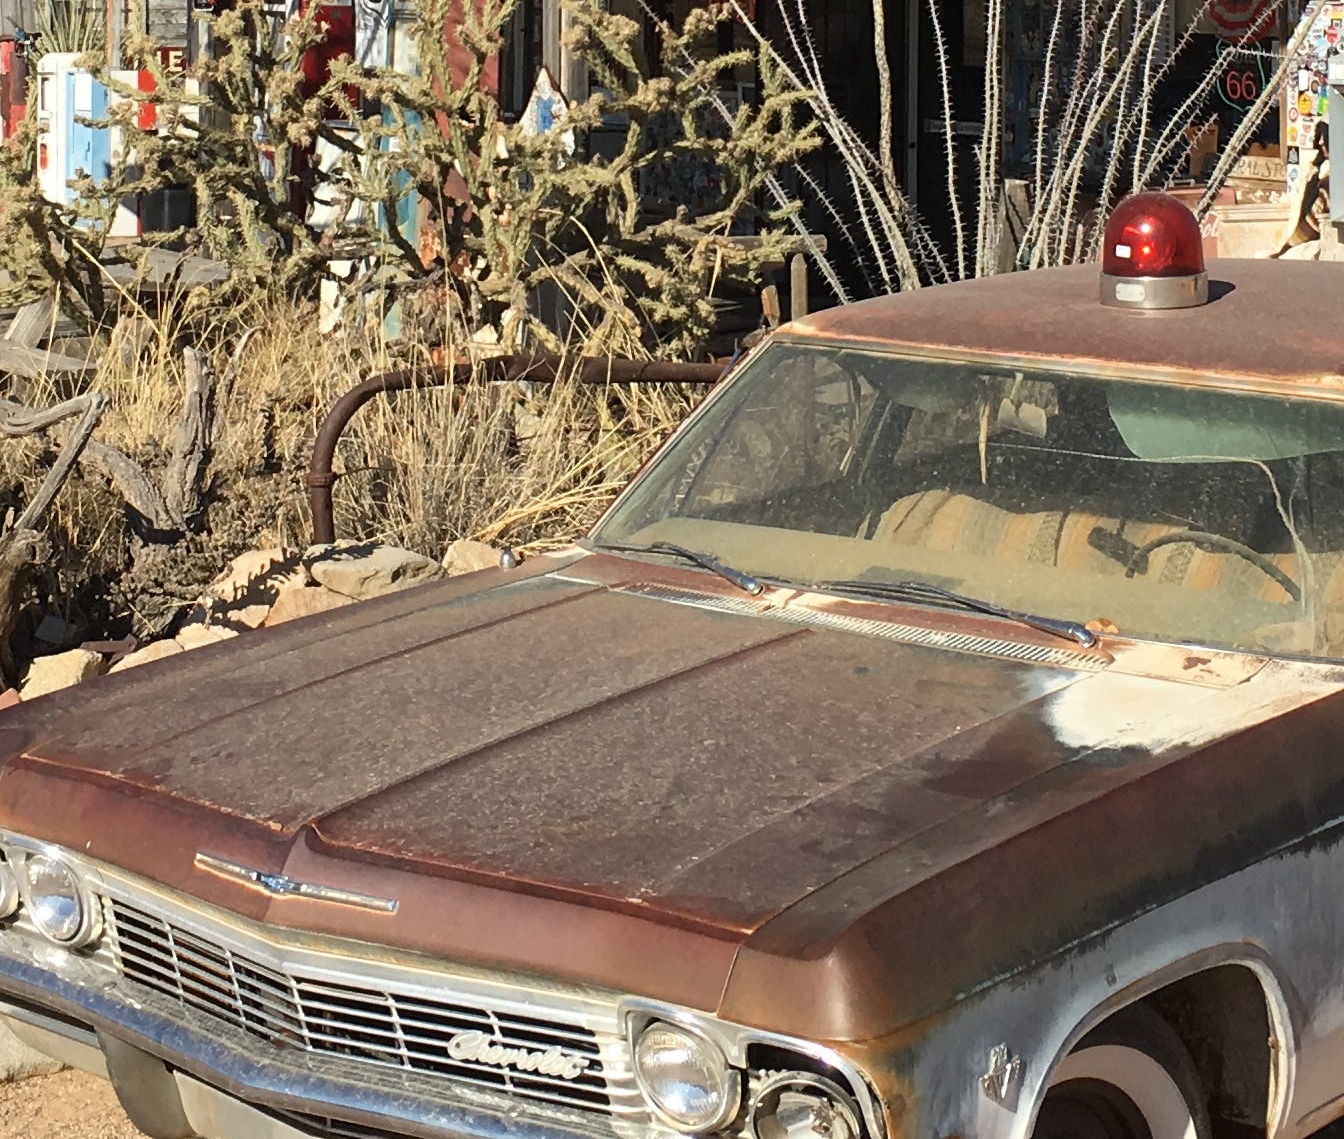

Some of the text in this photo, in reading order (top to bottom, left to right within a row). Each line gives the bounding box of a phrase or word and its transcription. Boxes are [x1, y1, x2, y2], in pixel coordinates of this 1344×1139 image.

[1226, 70, 1256, 100] 66
[1261, 159, 1286, 178] STO
[447, 1029, 591, 1080] Chevrolet
